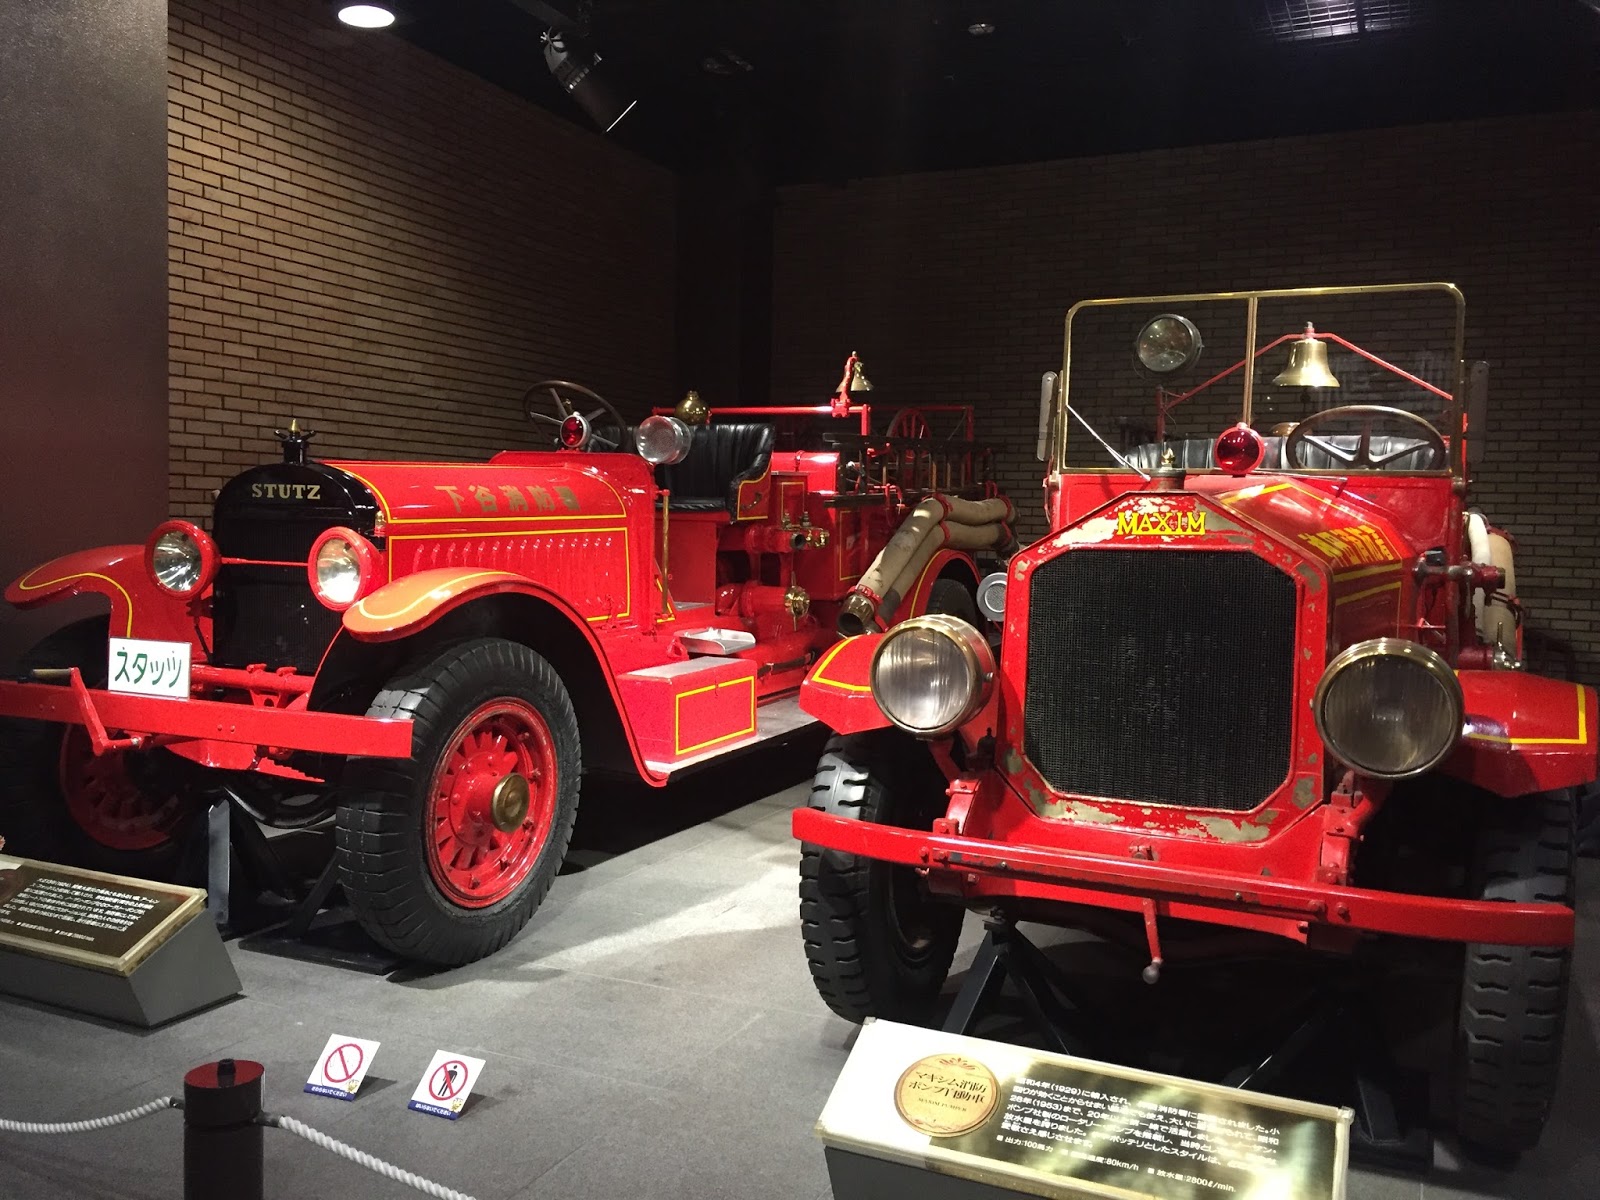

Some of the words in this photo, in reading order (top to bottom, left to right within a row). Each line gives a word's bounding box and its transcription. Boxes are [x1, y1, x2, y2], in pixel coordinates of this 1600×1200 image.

[252, 483, 321, 500] STUTZ
[434, 484, 581, 513] 下谷消防署
[1117, 511, 1206, 535] MAXIM
[115, 650, 182, 688] スタッツ
